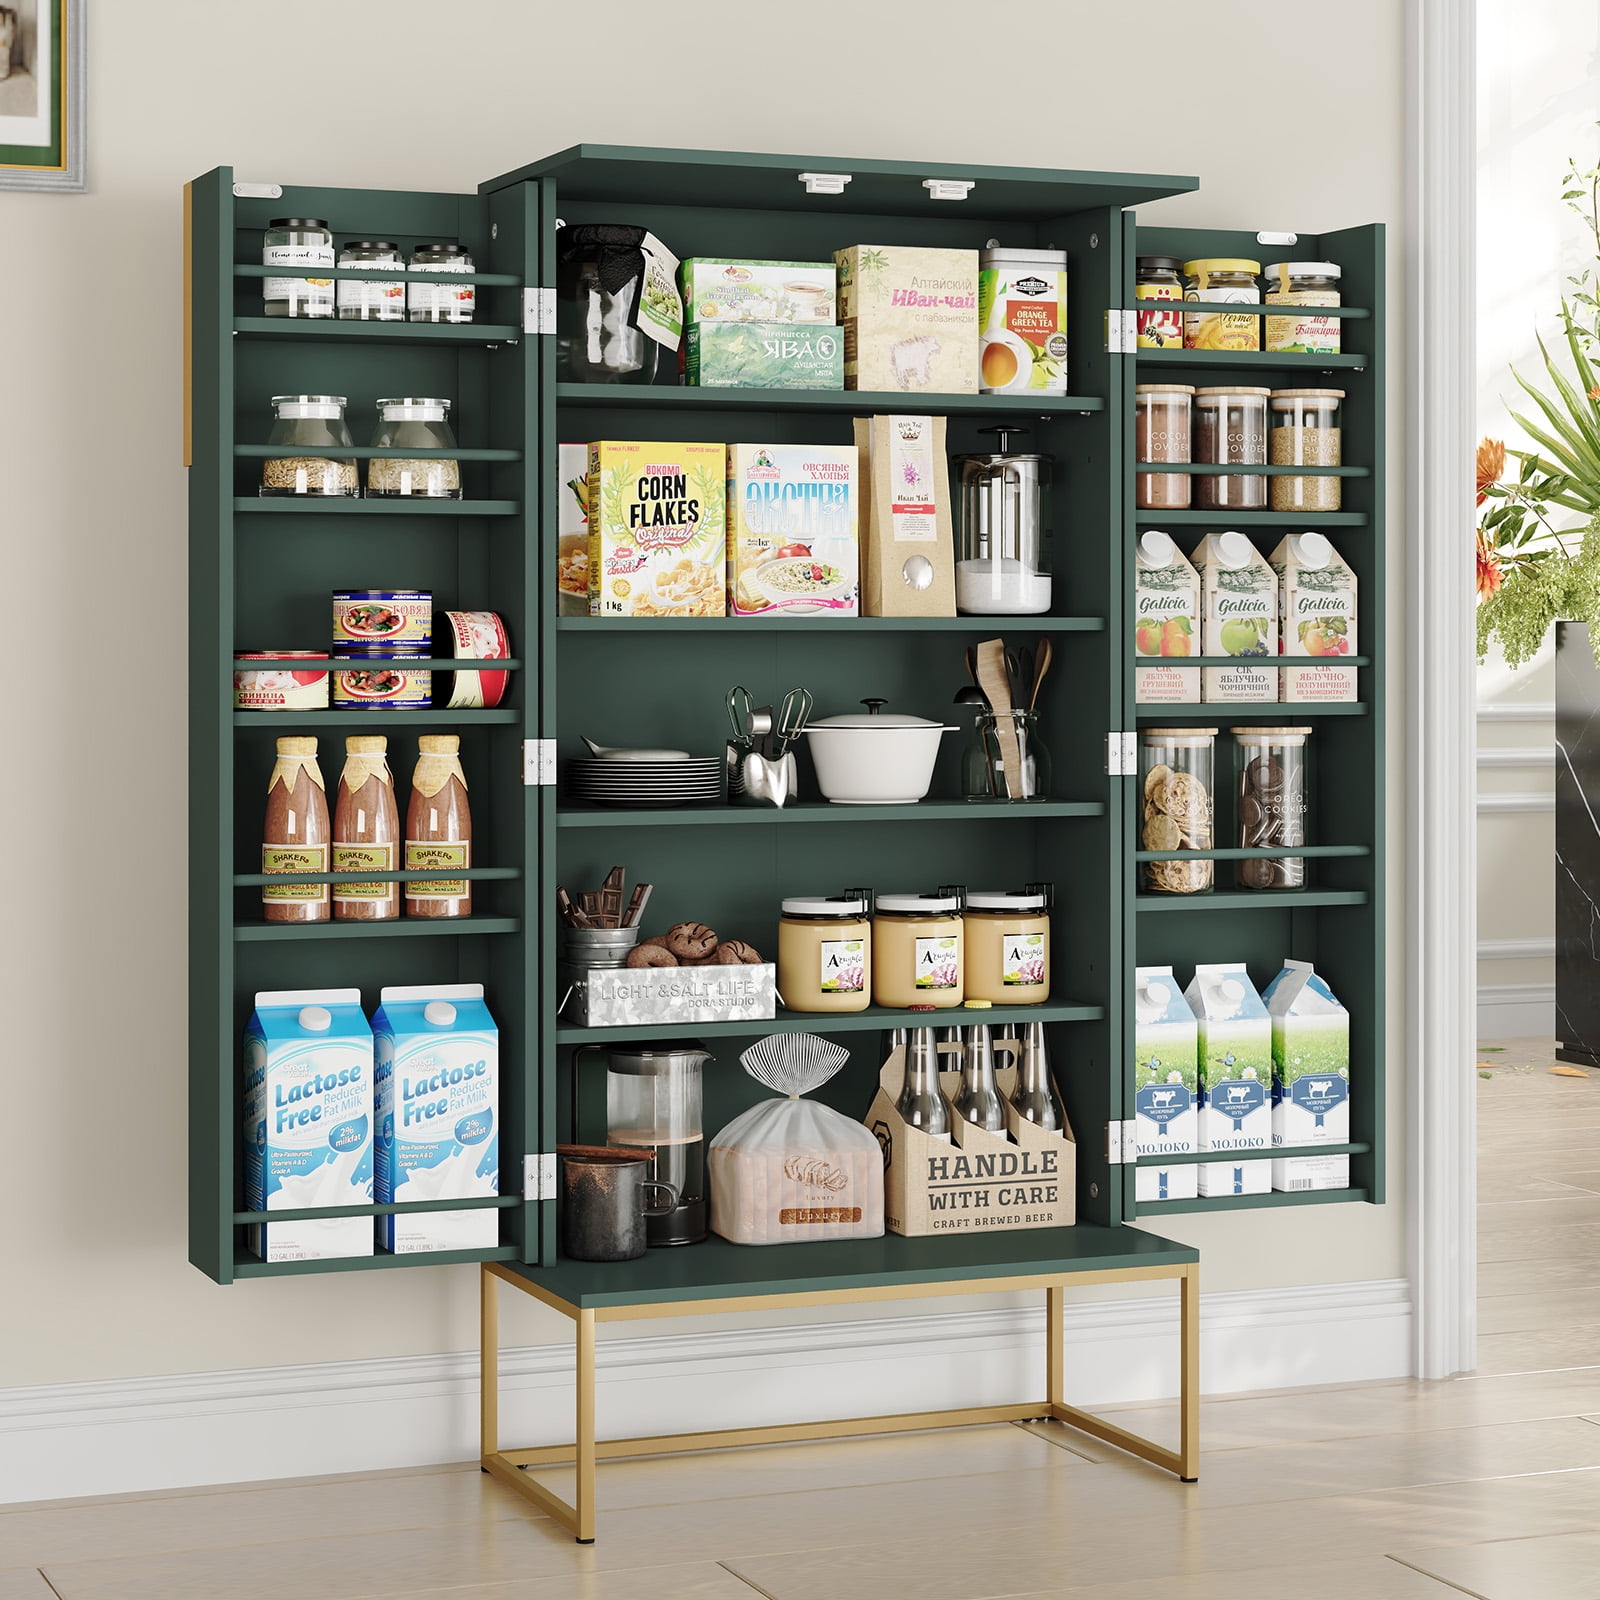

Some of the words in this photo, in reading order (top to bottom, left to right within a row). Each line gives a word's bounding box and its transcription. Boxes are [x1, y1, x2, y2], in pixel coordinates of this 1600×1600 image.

[911, 276, 972, 290] Алтайский
[891, 289, 976, 309] Иван-чай
[1016, 310, 1048, 319] ORANGE
[1011, 318, 1037, 327] GREEN
[1039, 319, 1053, 327] TEA
[762, 340, 815, 359] ЯВА
[1152, 431, 1187, 441] COCOA
[1228, 433, 1263, 442] COCOA
[645, 465, 680, 476] BOKOMO
[810, 472, 849, 481] ХЛОПЬЯ
[638, 474, 686, 501] CORN
[630, 499, 699, 528] FLAKES
[745, 482, 849, 533] ЭКСТРА
[635, 521, 694, 547] Original
[606, 601, 610, 610] 1
[612, 601, 623, 612] kg
[1139, 596, 1190, 614] Galicia
[1218, 598, 1270, 616] Galicia
[1298, 597, 1349, 614] Galicia
[1274, 794, 1303, 803] OREO
[1264, 804, 1307, 814] COOKIES
[272, 853, 309, 864] SHAKER
[338, 852, 374, 862] SHAKER
[416, 850, 453, 860] SHAKER
[601, 985, 653, 1001] LIGHT
[718, 980, 755, 996] LIFE
[688, 999, 717, 1009] DORA
[718, 997, 755, 1007] STUDIO
[275, 1065, 361, 1108] Lactose
[403, 1059, 486, 1101] Lactose
[450, 1074, 492, 1099] Reduced
[324, 1081, 367, 1105] Reduced
[450, 1097, 464, 1111] Fat
[467, 1089, 487, 1105] Milk
[324, 1103, 340, 1117] Fat
[341, 1096, 362, 1112] Milk
[403, 1098, 448, 1127] Free
[276, 1104, 322, 1134] Free
[465, 1119, 480, 1130] 2%
[340, 1126, 354, 1137] 2%
[461, 1127, 486, 1140] milkfat
[335, 1134, 361, 1147] milkfat
[1136, 1142, 1190, 1154] МОЛОКО
[1211, 1137, 1264, 1150] МОЛОКО
[927, 1150, 1058, 1181] HANDLE
[928, 1190, 990, 1211] WITH
[998, 1186, 1058, 1207] CARE
[799, 1210, 843, 1221] Luxury
[933, 1218, 971, 1229] CRAFT
[974, 1215, 1021, 1227] BREWED
[1025, 1213, 1054, 1223] BEER
